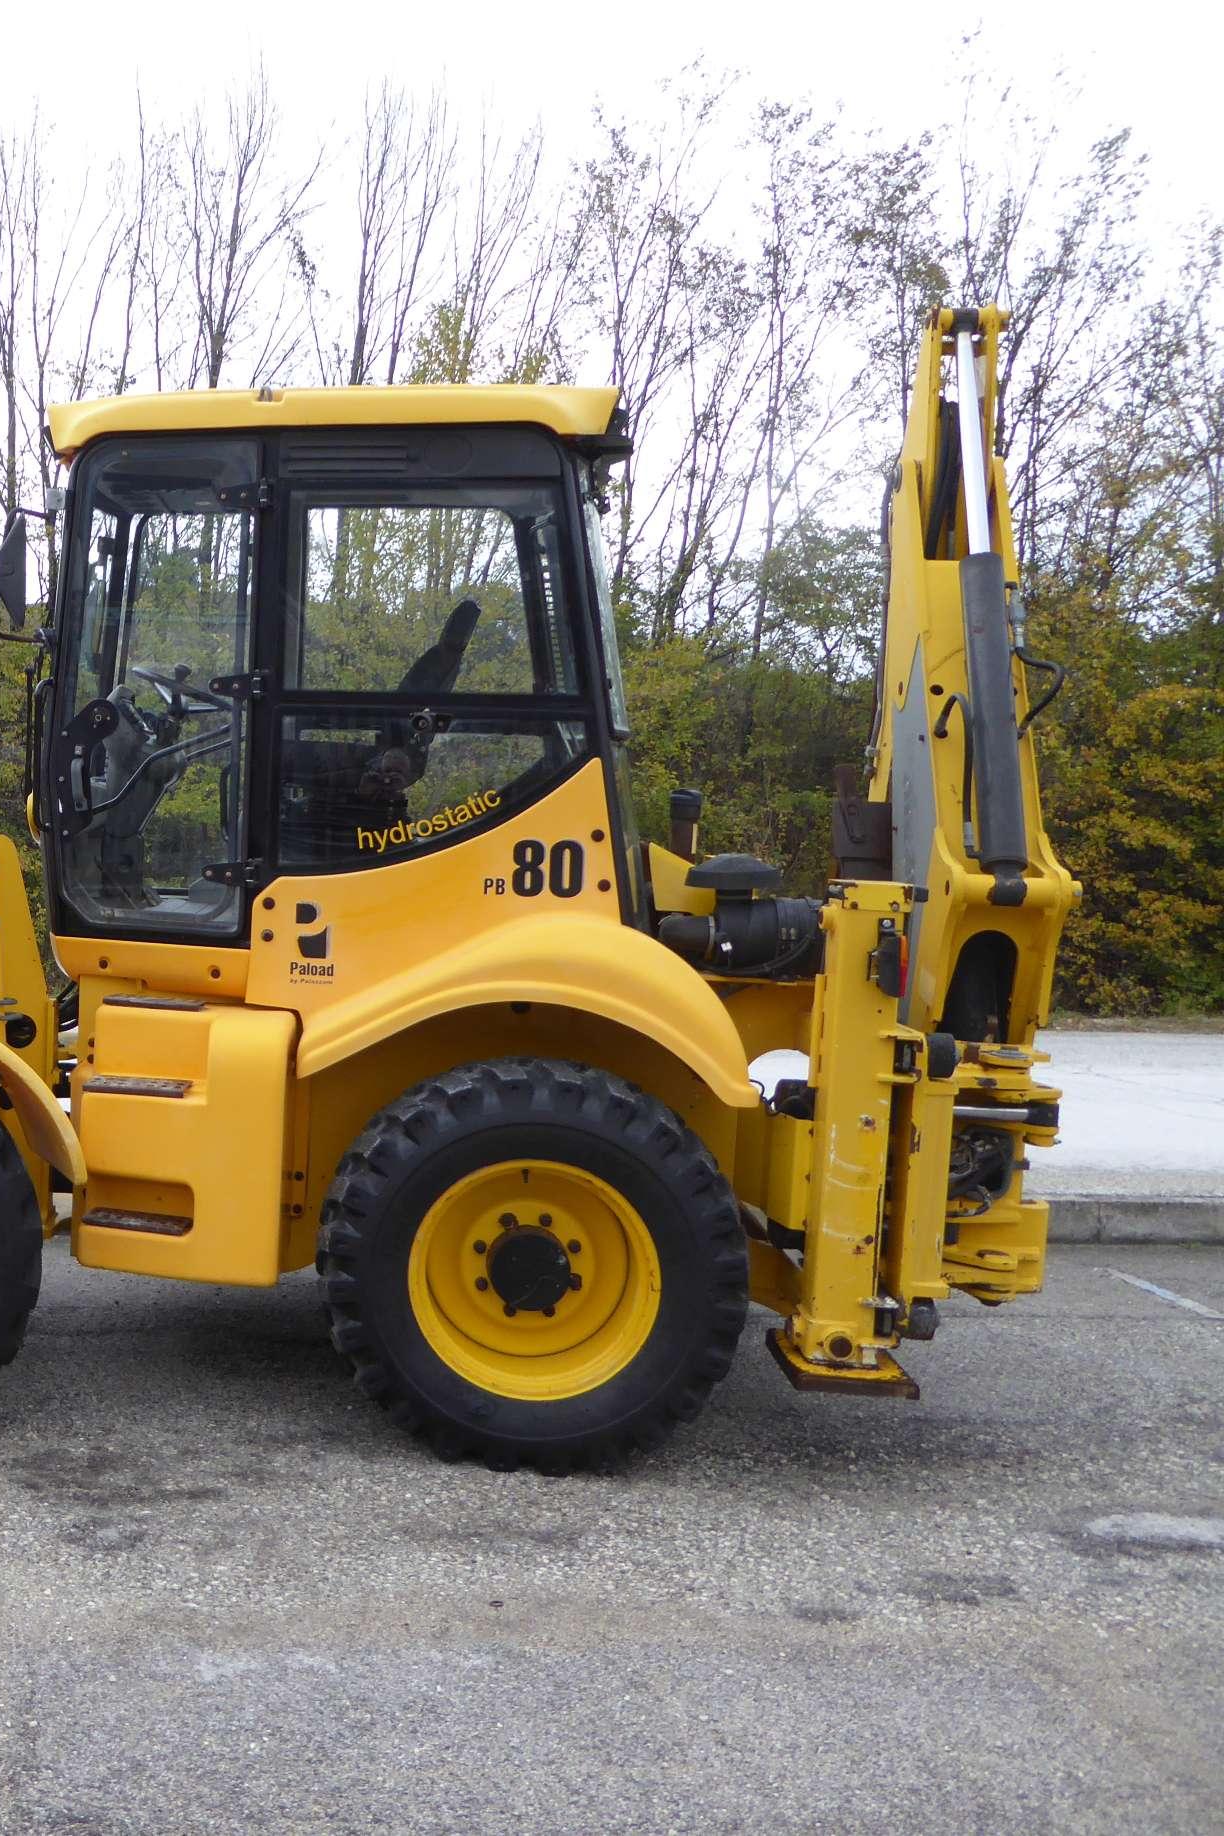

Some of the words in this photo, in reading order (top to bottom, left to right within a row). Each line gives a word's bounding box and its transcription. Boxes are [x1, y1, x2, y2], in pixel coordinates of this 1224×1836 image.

[357, 789, 501, 853] hydrostatic
[483, 878, 505, 895] PB
[512, 839, 584, 898] 80
[289, 961, 334, 977] Paload
